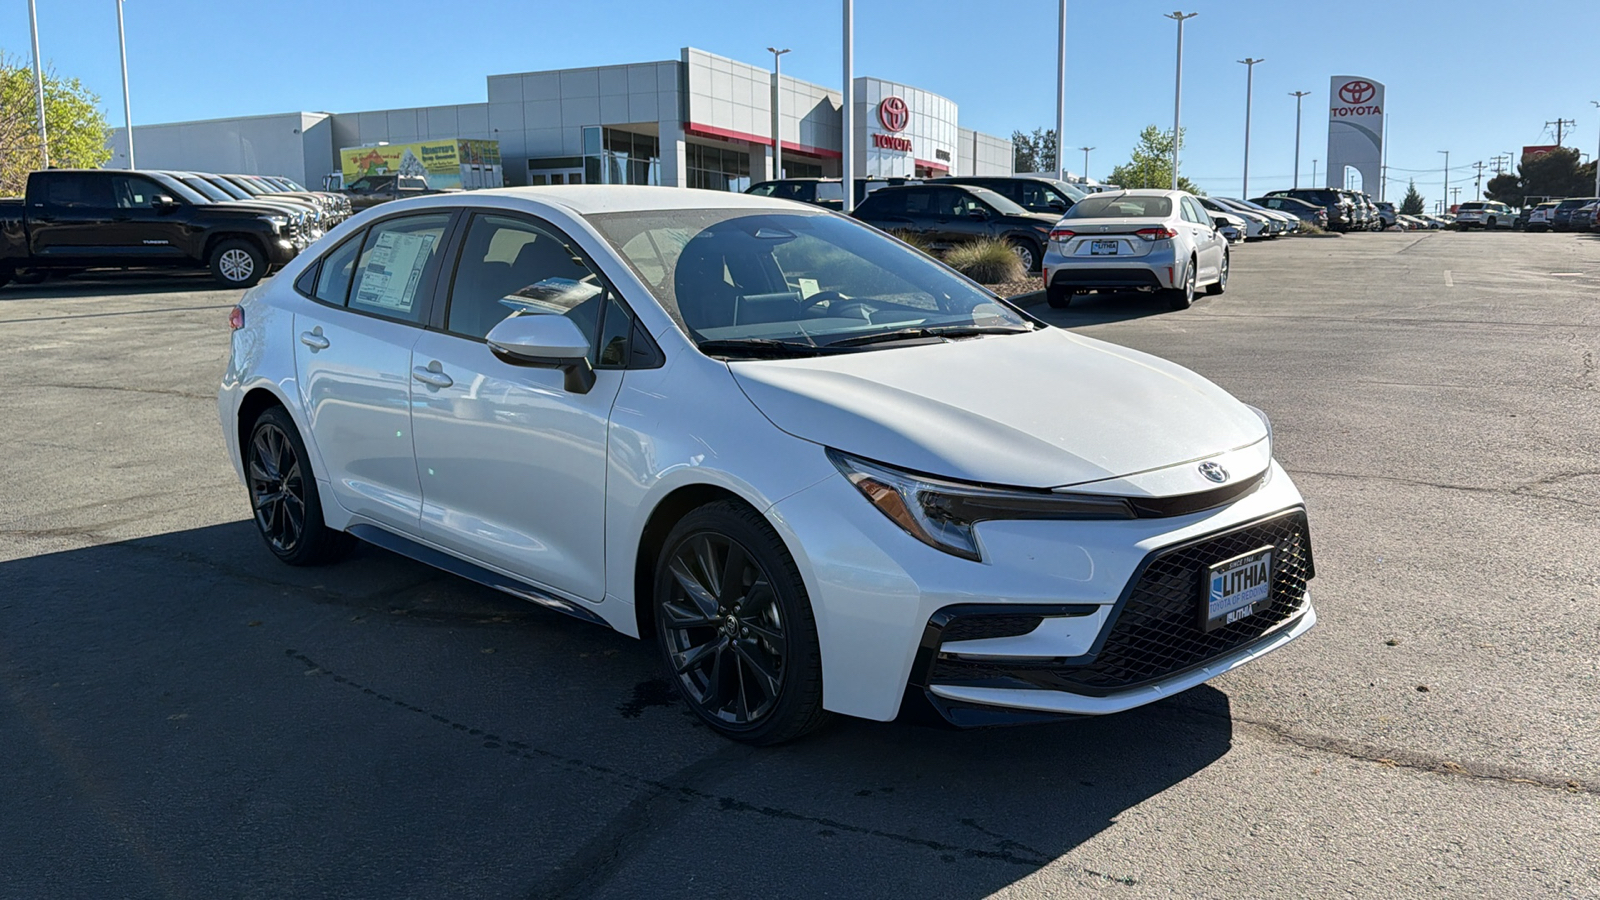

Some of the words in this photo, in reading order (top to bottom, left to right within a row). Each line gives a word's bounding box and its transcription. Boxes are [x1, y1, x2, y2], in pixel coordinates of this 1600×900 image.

[1331, 105, 1381, 117] TOYOTA
[872, 133, 913, 152] TOYOTA
[1223, 562, 1267, 597] LITHIA
[1210, 599, 1231, 613] TOYOTA
[1232, 595, 1241, 605] OF
[1241, 584, 1267, 601] REDDING
[1232, 604, 1253, 621] LITHIA
